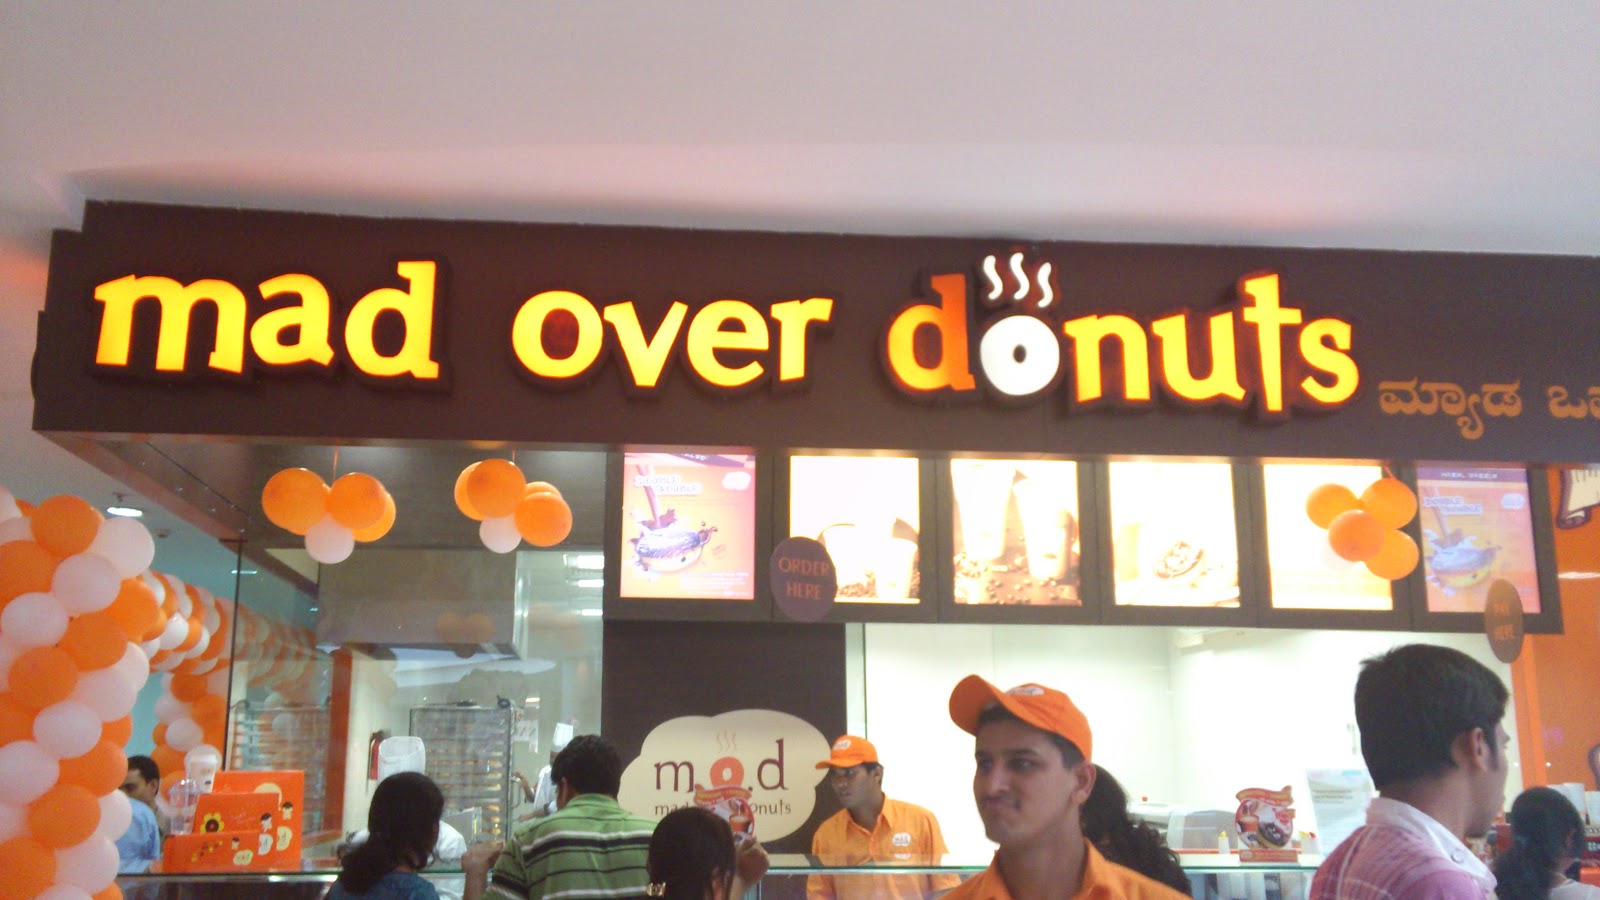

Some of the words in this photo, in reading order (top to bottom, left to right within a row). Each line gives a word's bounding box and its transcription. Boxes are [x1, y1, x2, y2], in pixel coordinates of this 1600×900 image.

[94, 261, 439, 379] mad
[512, 290, 833, 387] over
[887, 272, 1359, 411] donuts
[777, 557, 830, 577] ORDER
[786, 582, 822, 600] HERE
[752, 800, 792, 816] onuts
